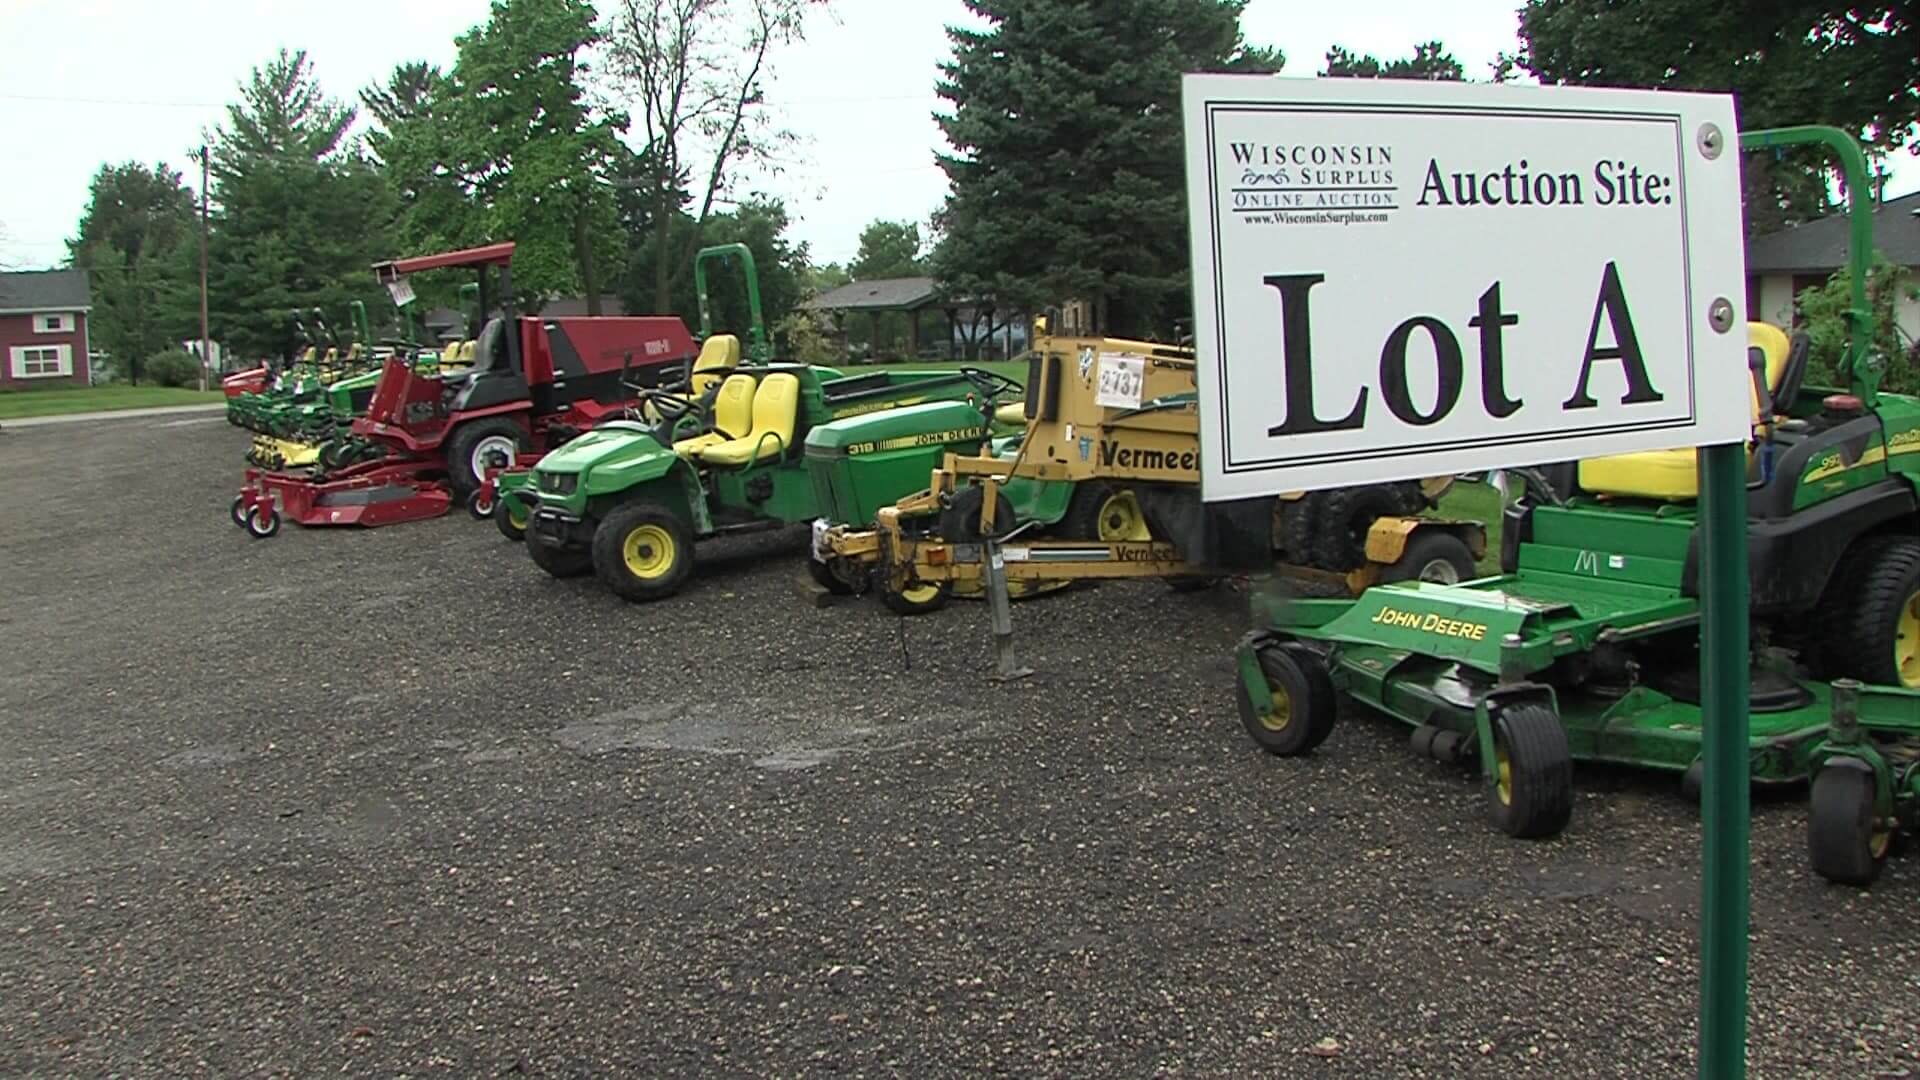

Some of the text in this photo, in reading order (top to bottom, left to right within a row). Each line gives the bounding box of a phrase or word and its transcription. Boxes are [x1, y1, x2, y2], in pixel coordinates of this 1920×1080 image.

[1230, 142, 1392, 165] WISCONSIN
[1301, 167, 1392, 185] SURPLUS
[1416, 157, 1672, 206] Auction Site:
[1234, 192, 1393, 207] ONLINE AUCTION
[1244, 211, 1389, 226] www.WisconsinSurplus.com
[1263, 260, 1664, 438] Lot A
[848, 442, 874, 455] 318
[915, 432, 944, 445] JOHN
[1371, 606, 1488, 640] JOHN DEERE
